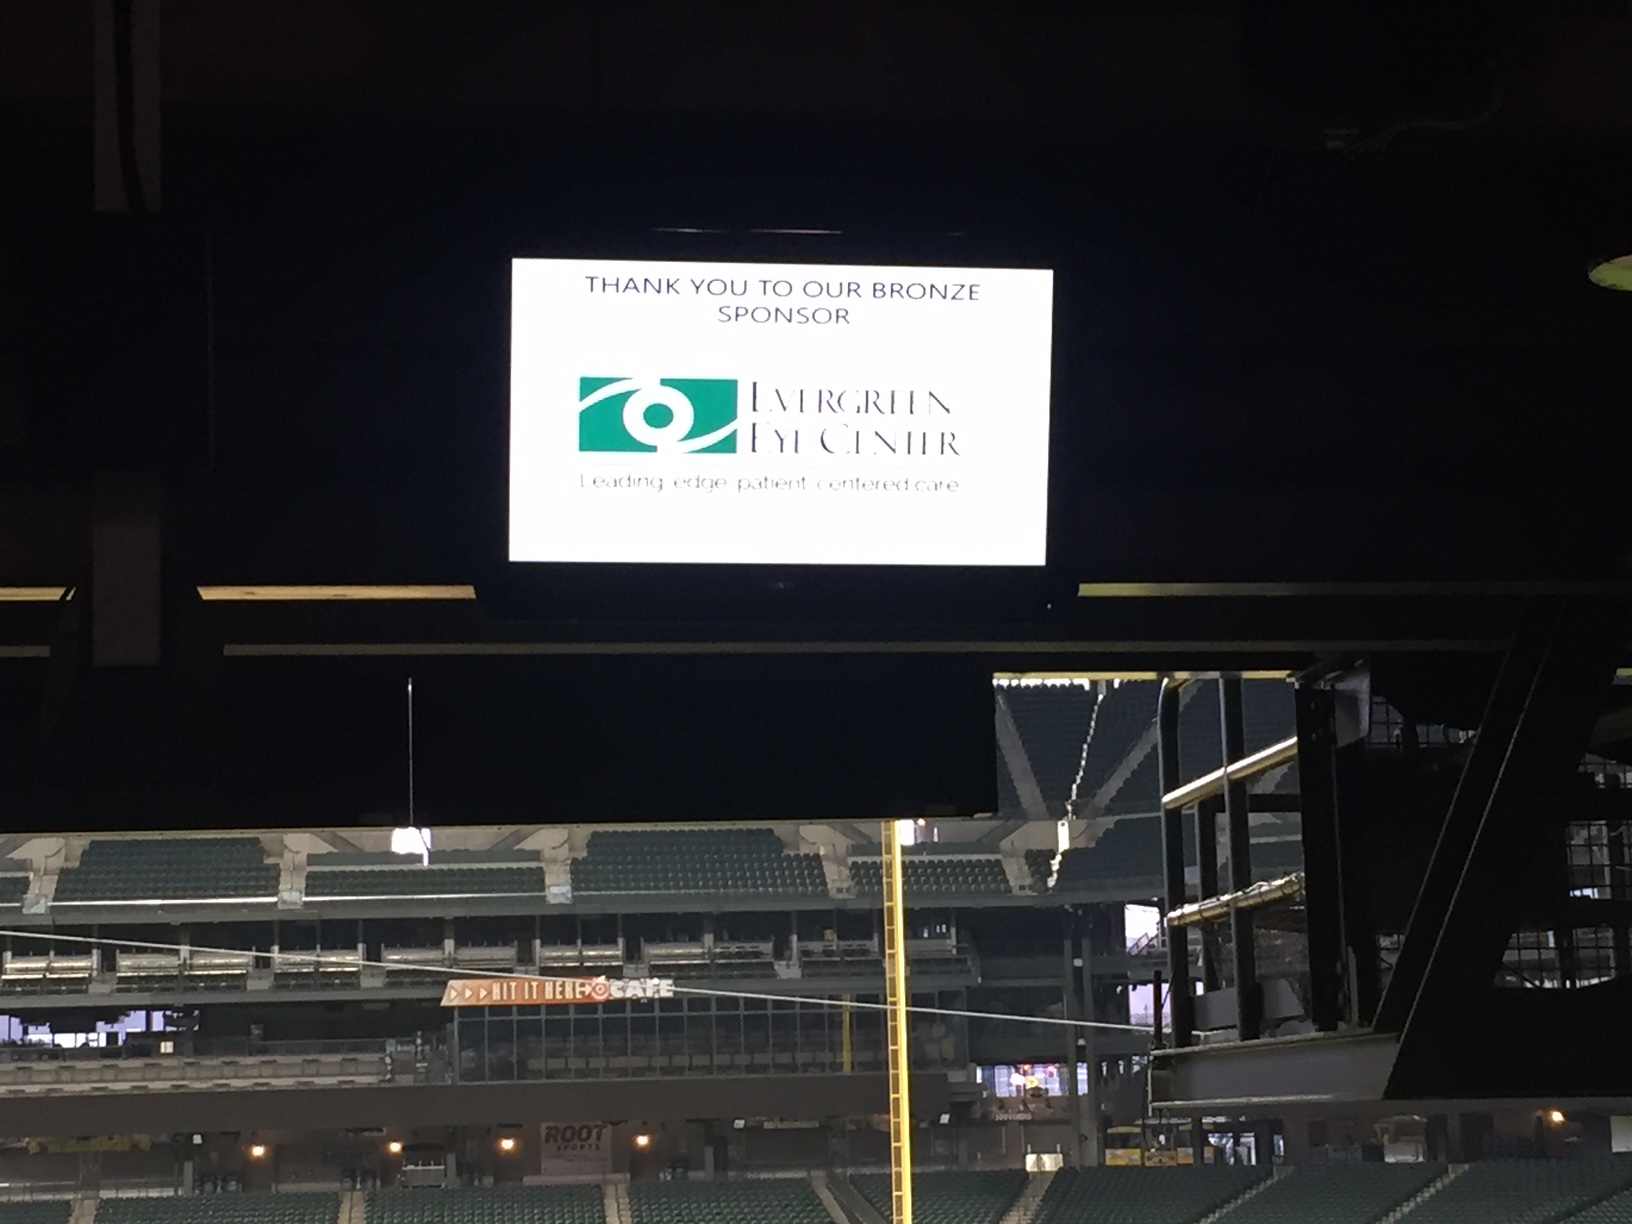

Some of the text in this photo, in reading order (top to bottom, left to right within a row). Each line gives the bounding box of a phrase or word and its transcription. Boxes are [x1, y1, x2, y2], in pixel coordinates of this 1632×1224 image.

[585, 275, 981, 301] THANK YOU TO OUR BRONZE
[718, 305, 850, 324] SPONSOR
[580, 473, 960, 494] Leading edge patient centered care
[492, 981, 517, 1001] HIT
[524, 981, 540, 1001] IT
[545, 981, 583, 1000] HERE
[544, 1125, 607, 1144] ROOT
